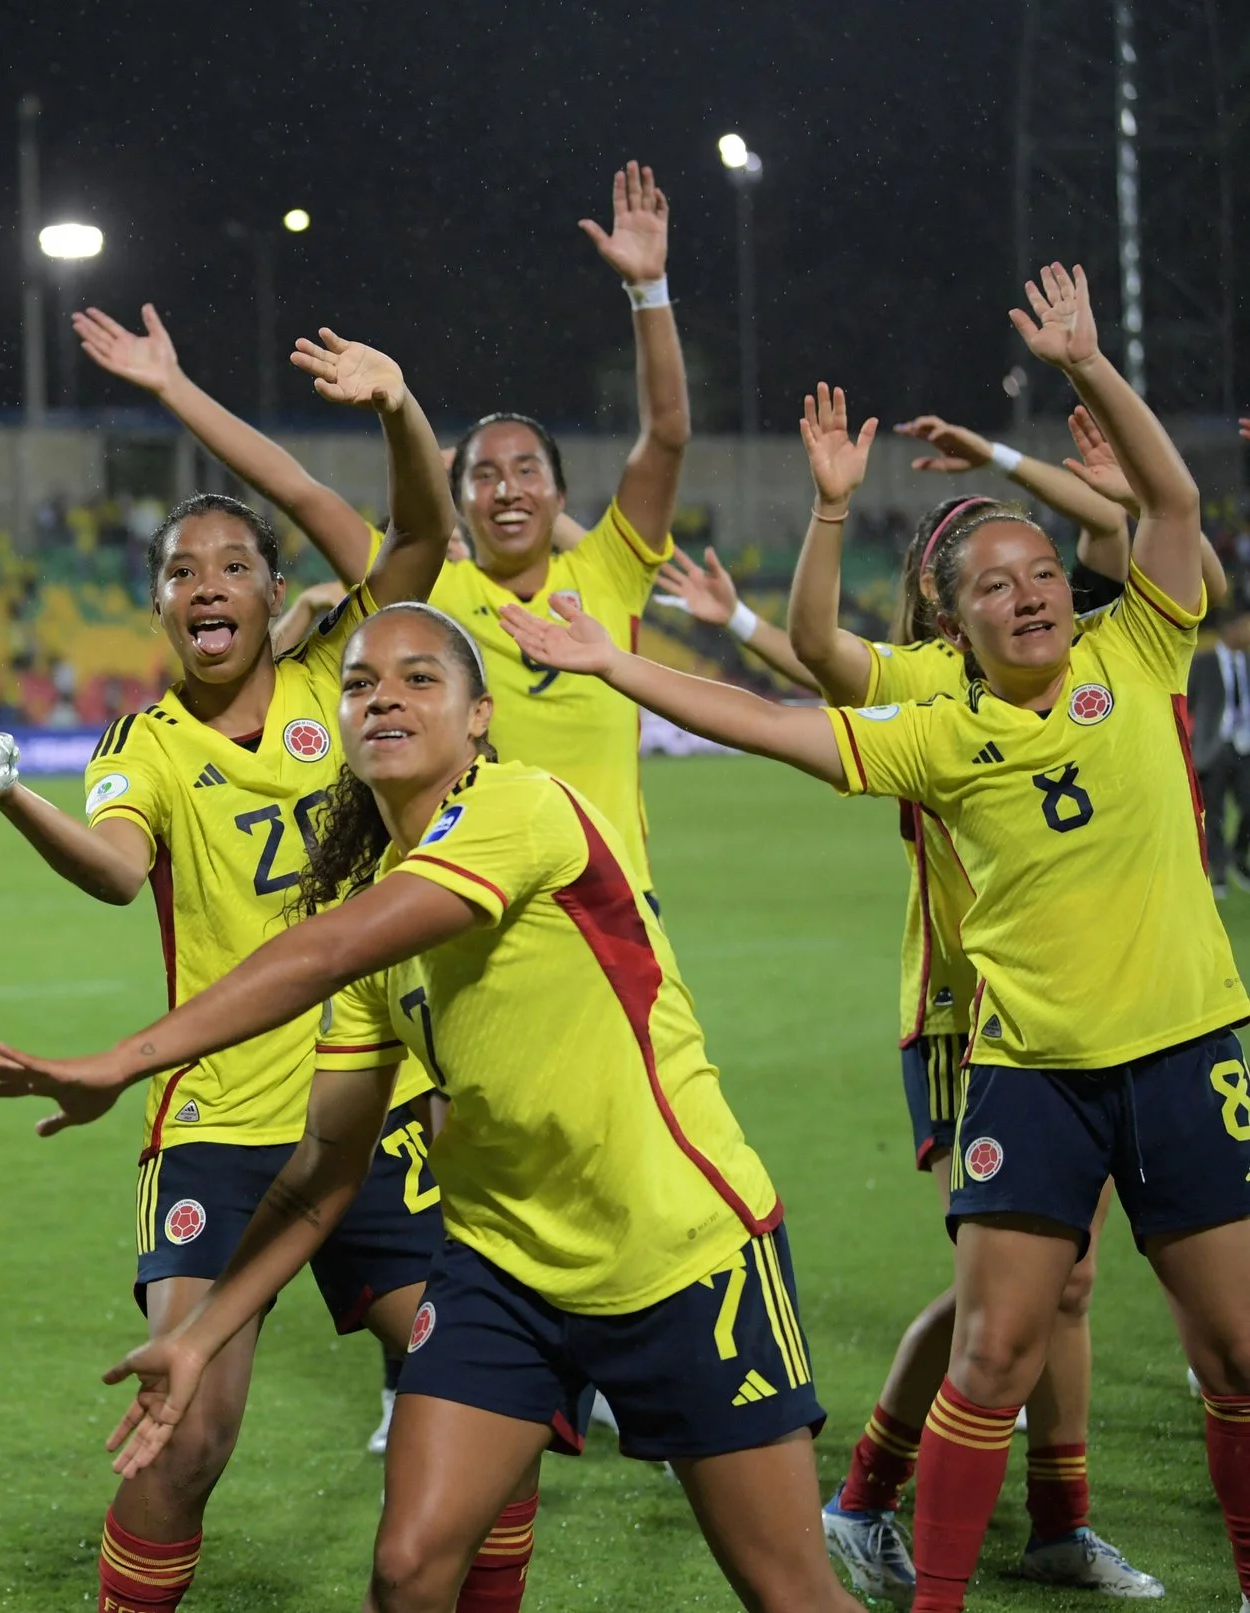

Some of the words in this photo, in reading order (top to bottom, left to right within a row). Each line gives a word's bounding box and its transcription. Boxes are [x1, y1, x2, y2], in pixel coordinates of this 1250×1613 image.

[1032, 760, 1094, 833] 8
[400, 986, 447, 1087] 7
[1210, 1059, 1250, 1142] 8
[697, 1250, 748, 1361] 7
